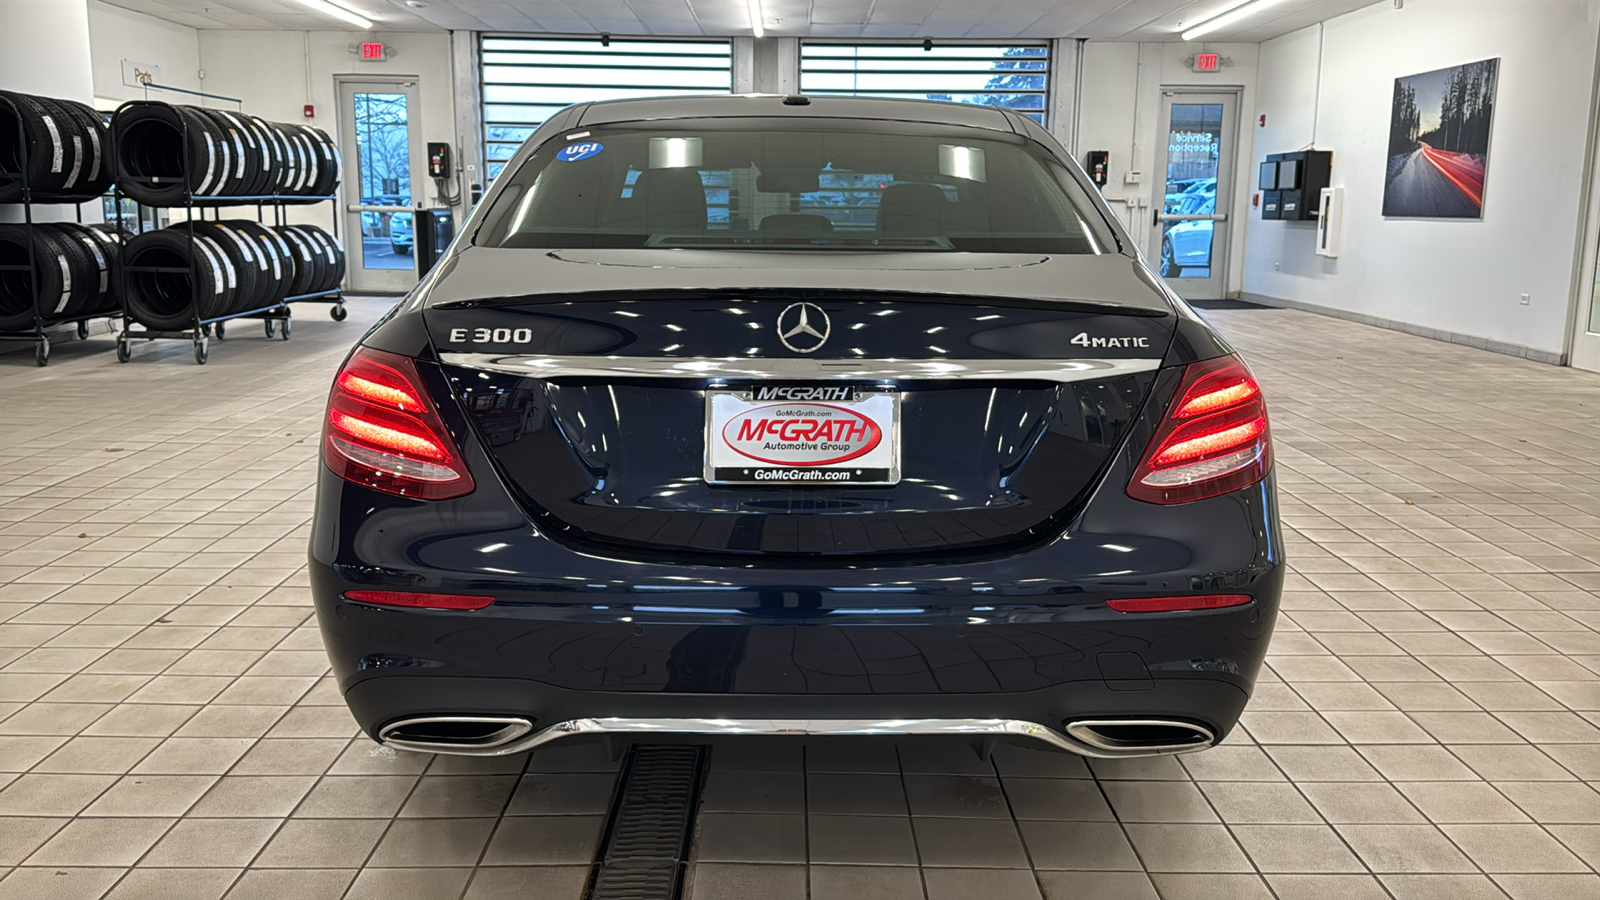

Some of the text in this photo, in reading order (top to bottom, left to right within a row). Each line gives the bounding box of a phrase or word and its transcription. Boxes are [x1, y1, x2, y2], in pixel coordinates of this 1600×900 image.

[362, 42, 382, 59] EXIT
[1197, 53, 1217, 69] EXIT
[134, 67, 153, 84] Parts
[449, 328, 532, 343] E 300
[1070, 332, 1150, 348] 4MATIC
[775, 409, 832, 417] GoMcGrath.com
[763, 441, 850, 452] Automotive Group
[754, 469, 850, 481] GoMcGrath.com
